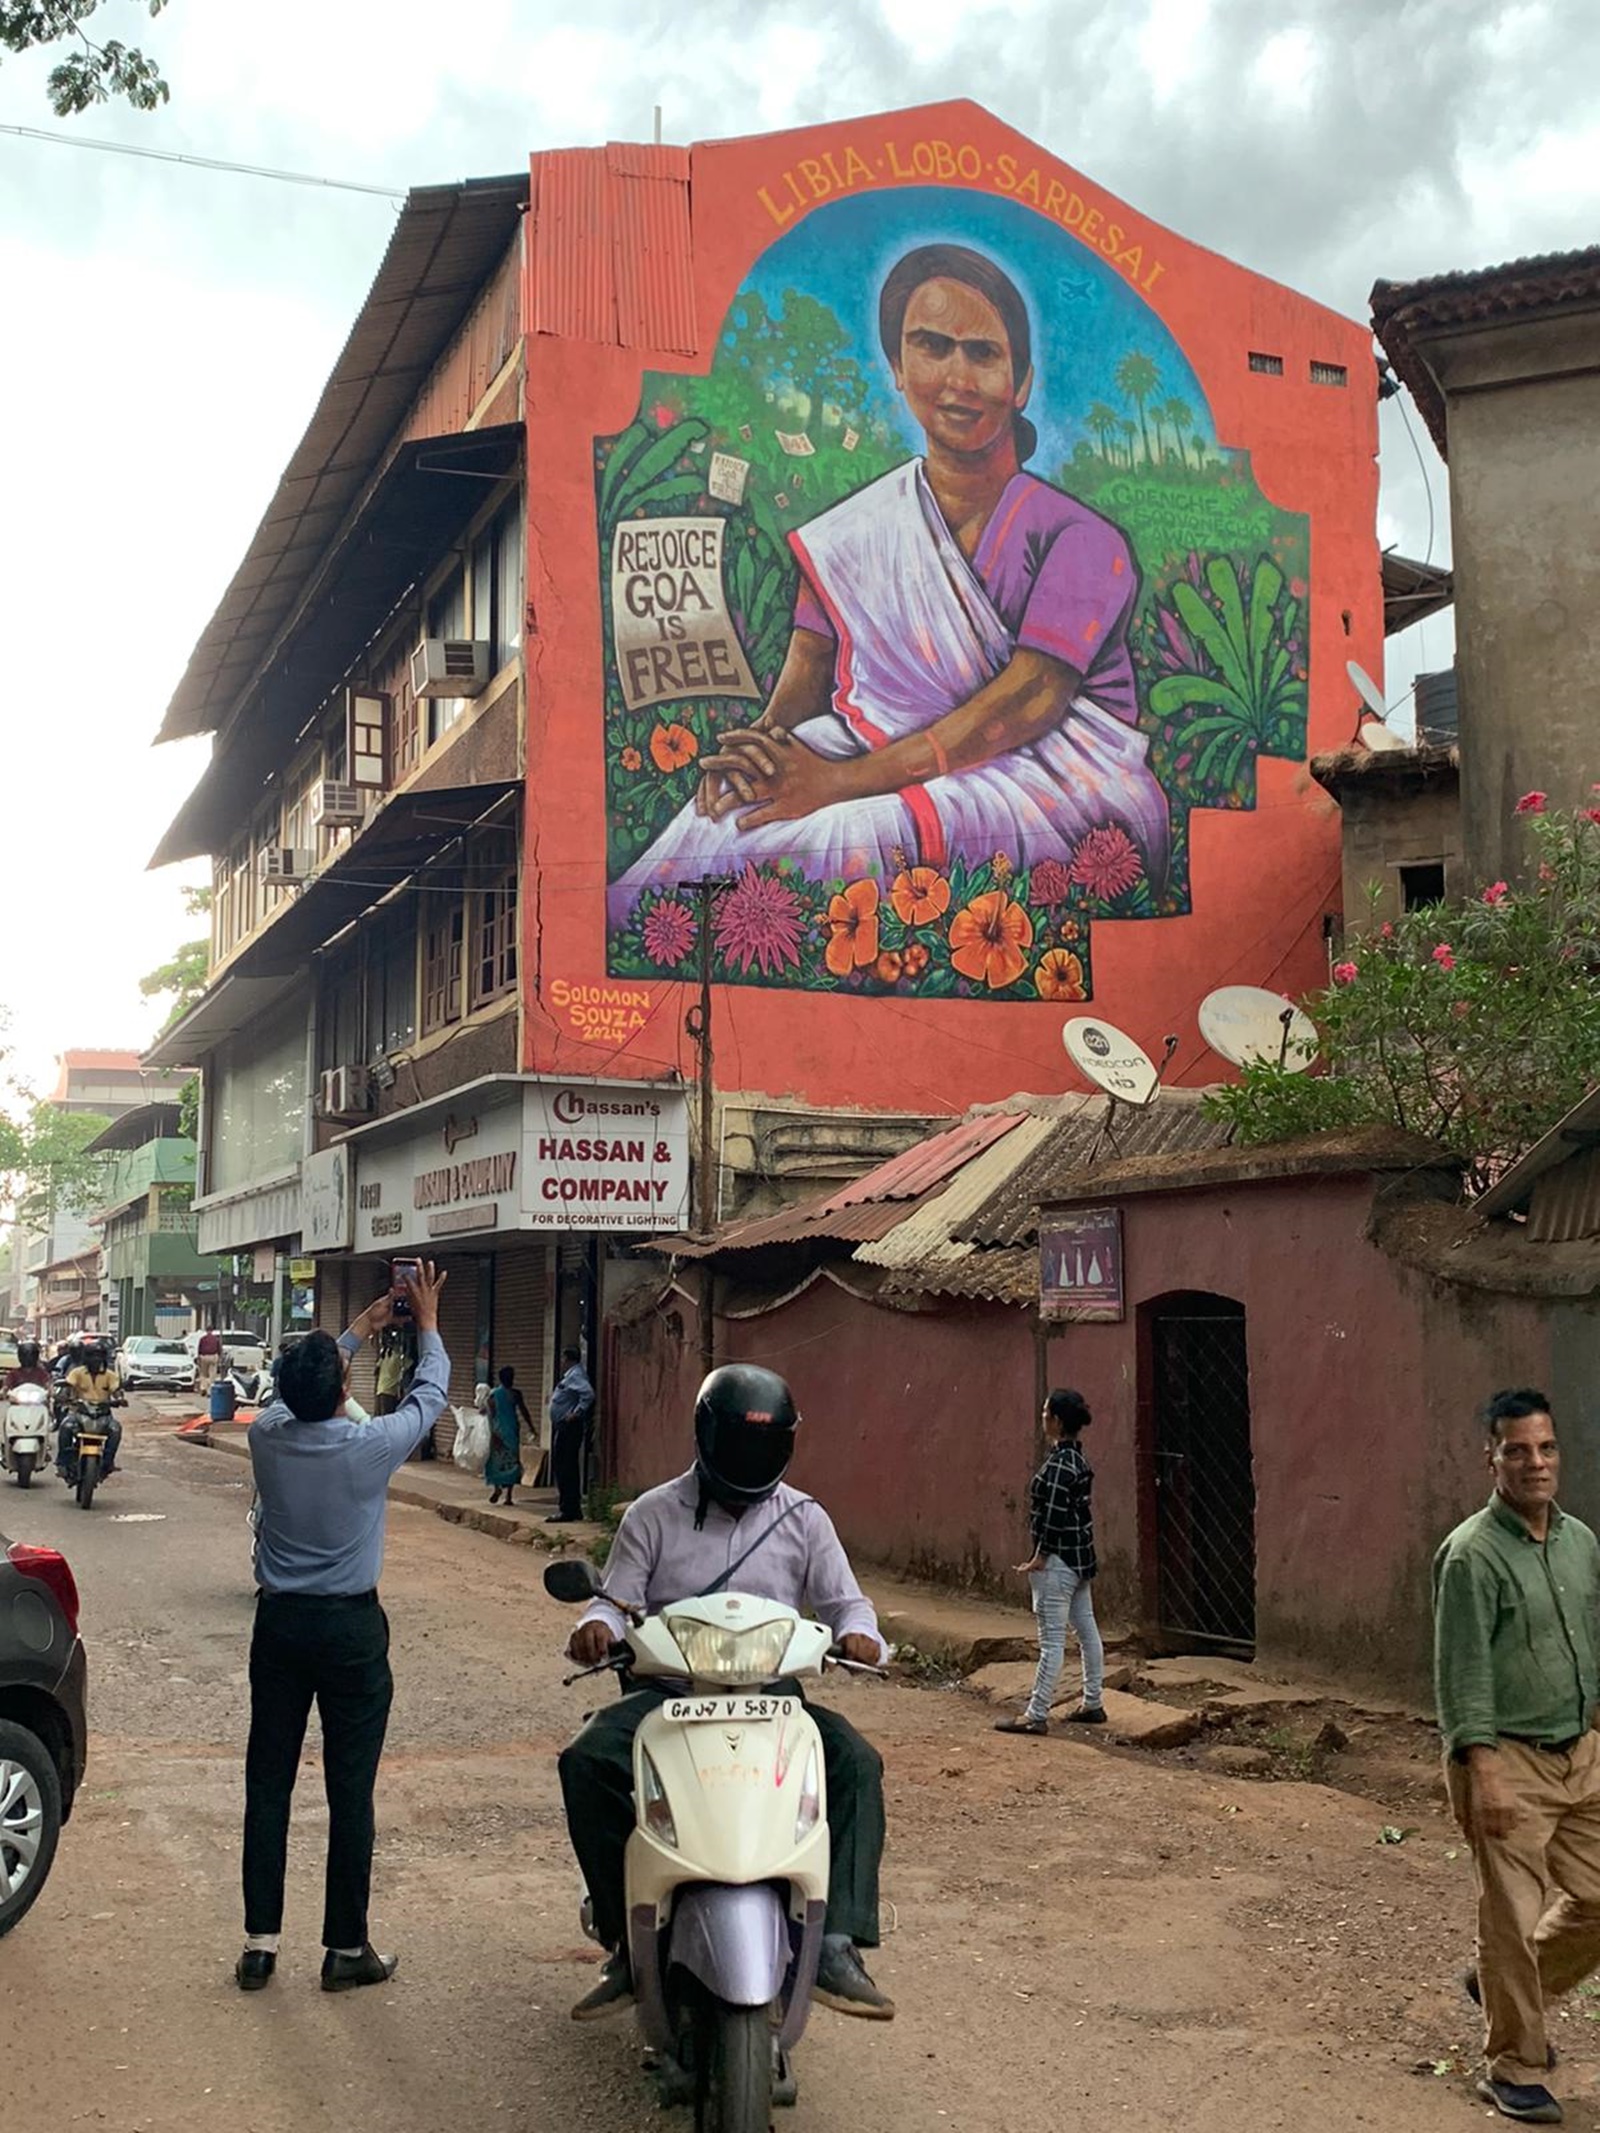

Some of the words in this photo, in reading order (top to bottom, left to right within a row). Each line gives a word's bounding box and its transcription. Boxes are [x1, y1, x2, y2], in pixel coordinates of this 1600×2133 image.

[757, 146, 875, 225] LIBIA
[885, 140, 981, 181] LOBO
[994, 154, 1165, 293] SARDESAI
[618, 529, 718, 573] REJOICE
[625, 571, 715, 618] GOA
[656, 615, 687, 641] IS
[626, 639, 741, 701] FREE
[550, 979, 651, 1008] SOLOMON
[569, 1004, 646, 1028] SOUZA
[583, 1025, 626, 1043] 2024
[539, 1139, 645, 1162] HASSAN
[653, 1141, 672, 1163] &
[541, 1177, 669, 1202] COMPANY
[532, 1214, 554, 1224] FOR
[557, 1214, 624, 1226] DECORATIVE
[627, 1215, 678, 1226] LIGHTING
[726, 1701, 737, 1716] V
